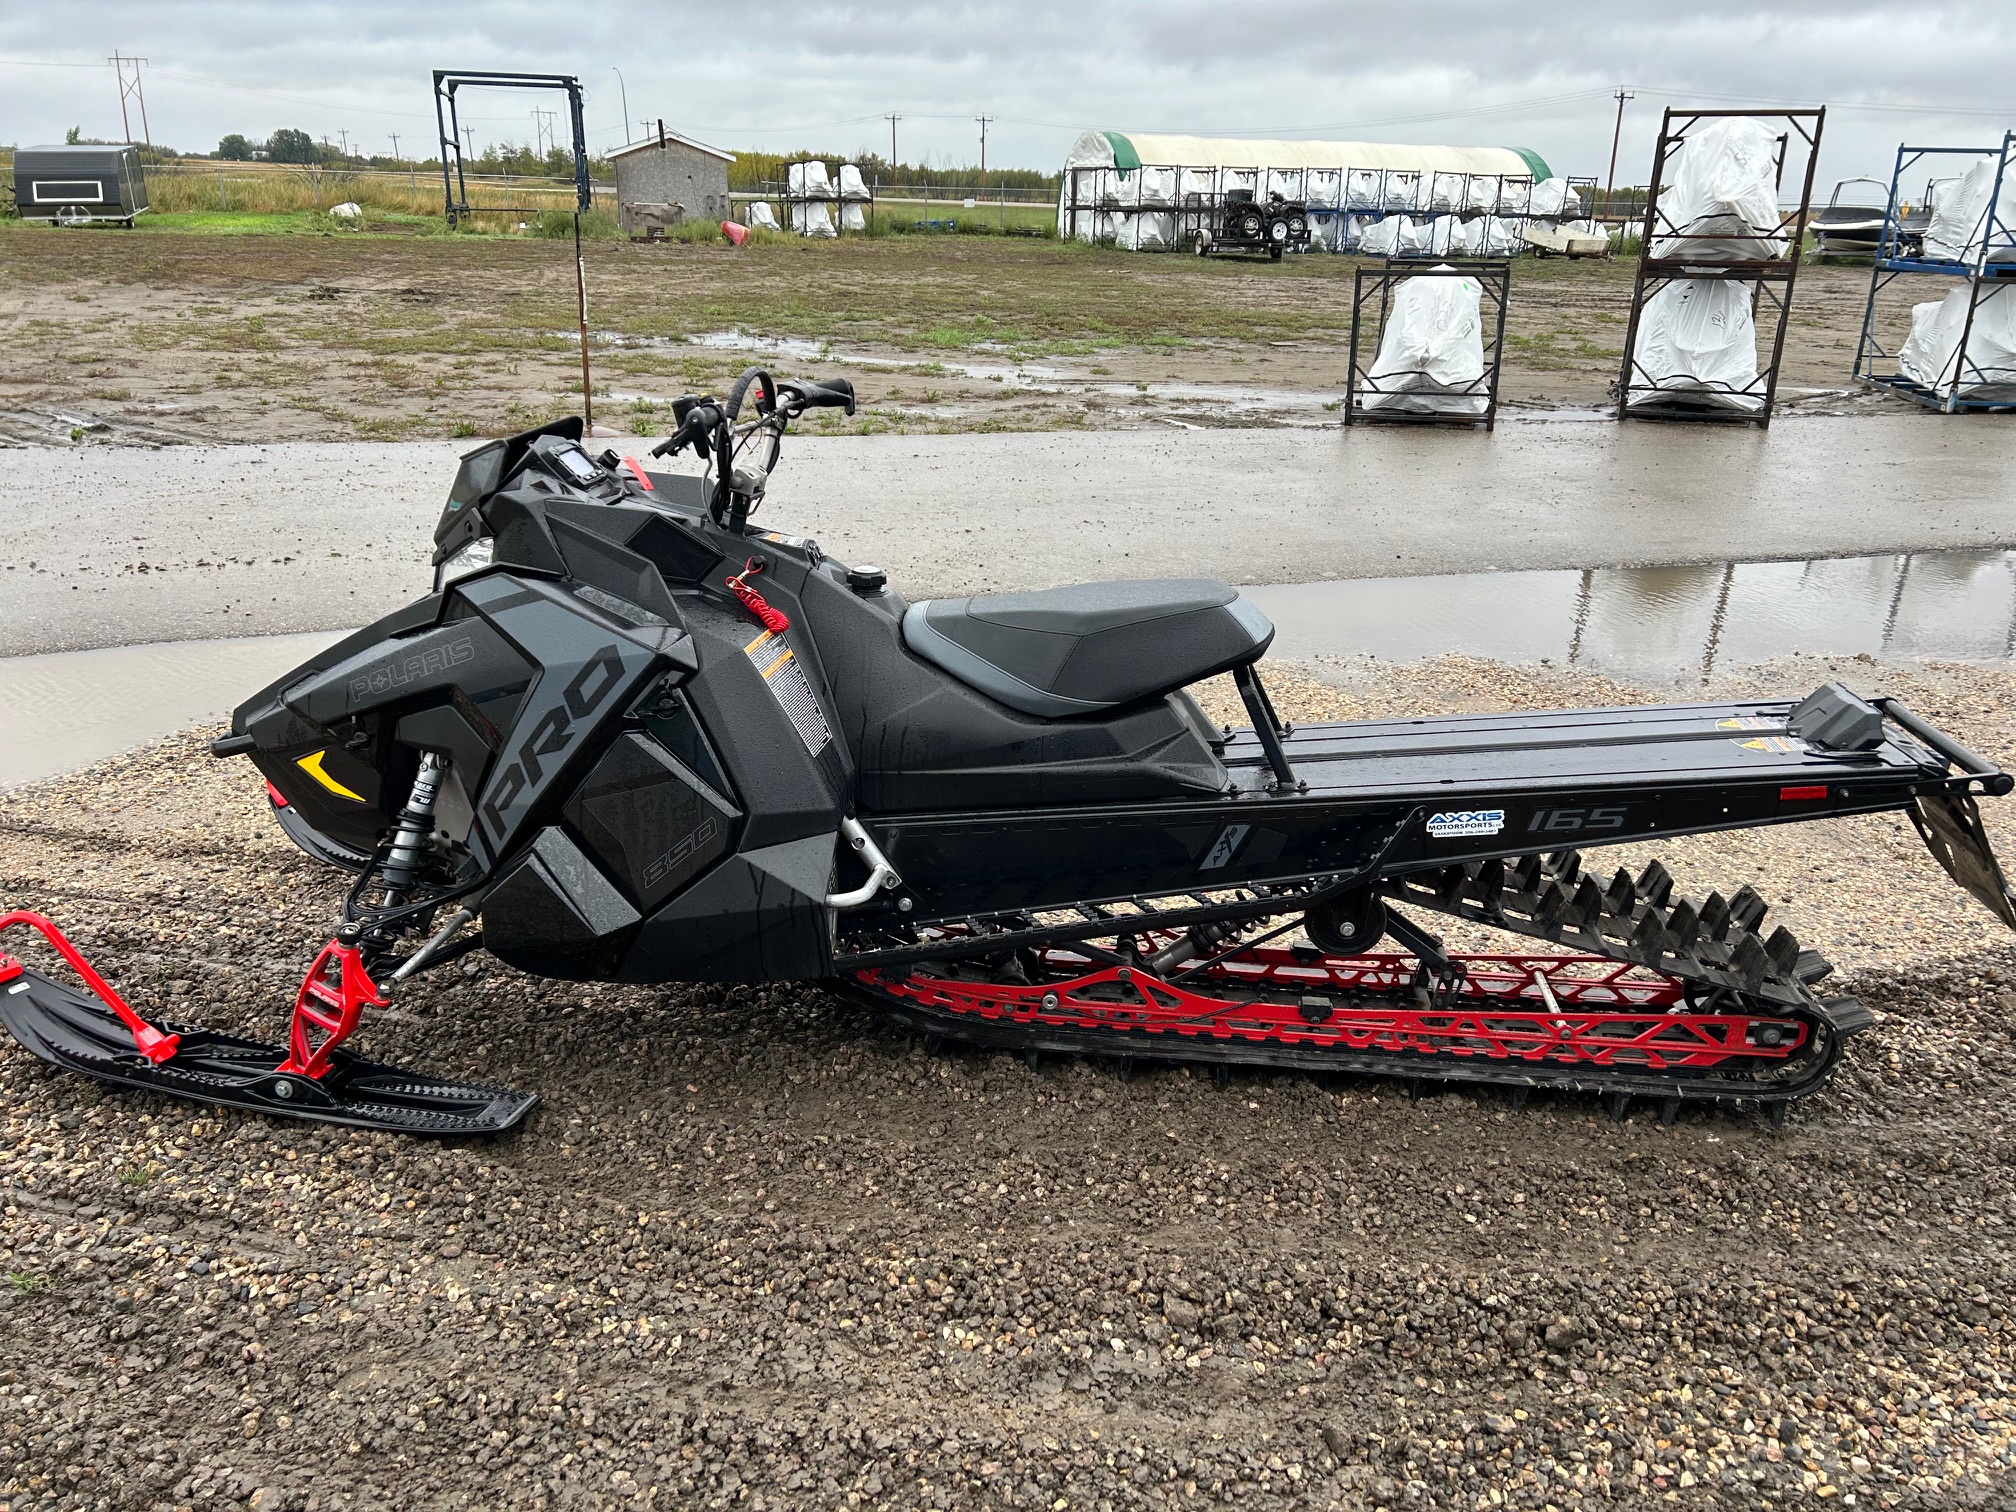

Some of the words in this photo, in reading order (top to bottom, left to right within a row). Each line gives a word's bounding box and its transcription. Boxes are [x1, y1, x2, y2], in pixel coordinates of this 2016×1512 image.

[350, 637, 475, 703] POLARIS
[482, 643, 626, 842] PRO
[1428, 822, 1493, 831] MOTORSPORTS
[1429, 811, 1503, 824] AXXIS
[1527, 807, 1628, 832] 165
[643, 816, 718, 890] 850
[1212, 826, 1239, 867] AXYS
[308, 986, 340, 1008] POLARIS
